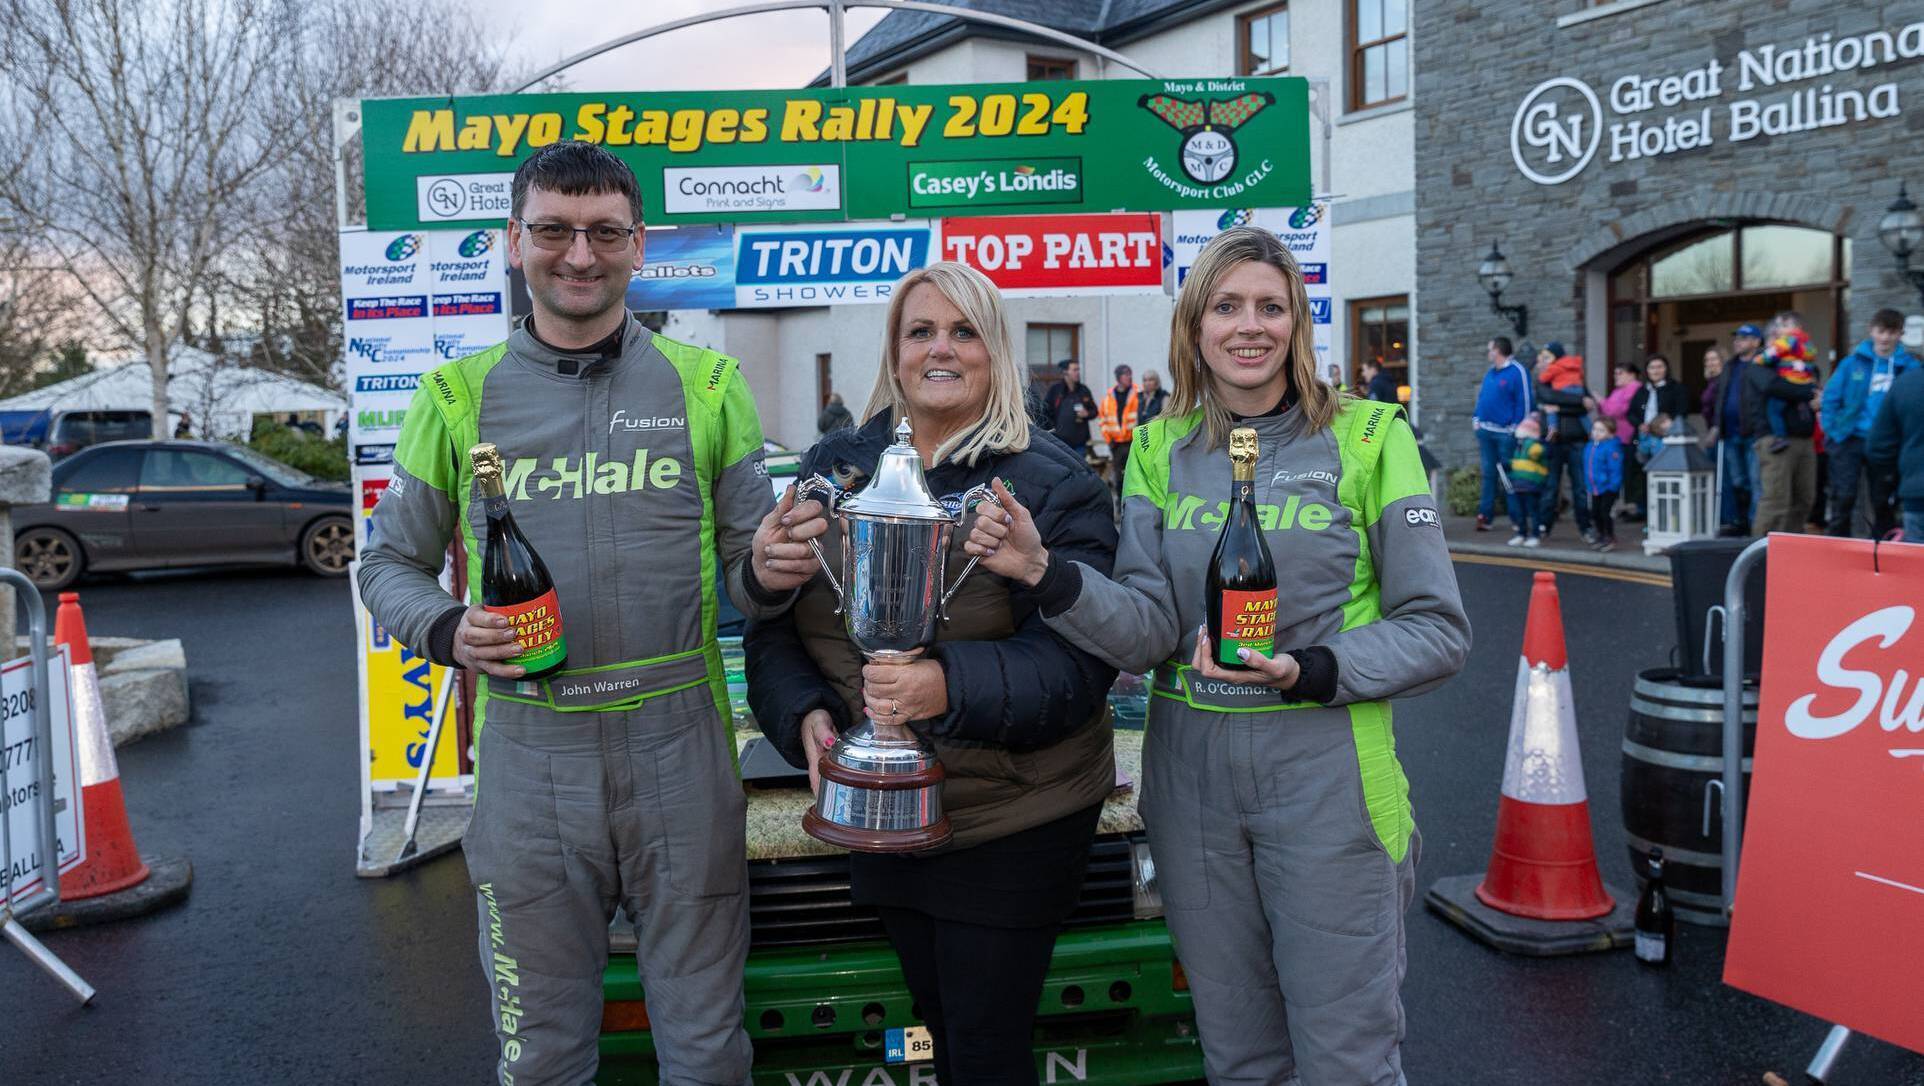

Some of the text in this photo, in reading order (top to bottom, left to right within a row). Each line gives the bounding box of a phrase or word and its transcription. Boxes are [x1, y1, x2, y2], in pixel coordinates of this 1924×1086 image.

[1611, 22, 1924, 114] Great Nationa
[1164, 81, 1245, 93] Mayo & District
[402, 92, 1088, 156] Mayo Stages Rally 2024
[1609, 83, 1900, 163] Hotel Ballina
[1191, 140, 1227, 150] M & D
[1190, 162, 1228, 172] M C
[913, 169, 1077, 195] Casey's Londis
[1143, 156, 1274, 199] Motorsport Club GLC
[469, 182, 504, 193] Great
[679, 175, 785, 196] Connacht
[470, 196, 510, 210] Hote
[706, 197, 786, 209] Print and Signs
[1177, 234, 1213, 244] Motor
[1279, 231, 1317, 244] rsport
[947, 232, 1156, 271] TOP PART
[1288, 242, 1314, 251] land
[752, 238, 912, 277] TRITON
[344, 263, 416, 276] Motorsport
[431, 260, 490, 273] torsport
[639, 265, 716, 279] allets
[367, 274, 414, 285] Ireland
[440, 270, 487, 281] Ireland
[453, 295, 470, 304] The
[470, 294, 495, 303] Race
[755, 286, 892, 301] SHOWER
[353, 297, 421, 309] Keep The Race
[459, 303, 494, 313] Place
[386, 307, 421, 317] Place
[707, 358, 728, 391] MARINA
[361, 376, 419, 390] TRITON
[431, 370, 457, 405] MARINA
[1361, 407, 1385, 443] MARINA
[500, 448, 682, 500] McHale
[516, 614, 555, 636] AGES
[1235, 611, 1276, 625] STAG
[1241, 625, 1274, 638] RALL
[519, 629, 553, 649] ALLY
[1784, 606, 1924, 739] Su
[561, 677, 640, 697] John Warren
[1195, 682, 1206, 693] R.
[1208, 683, 1267, 695] O'Connor
[888, 1048, 904, 1057] IRL
